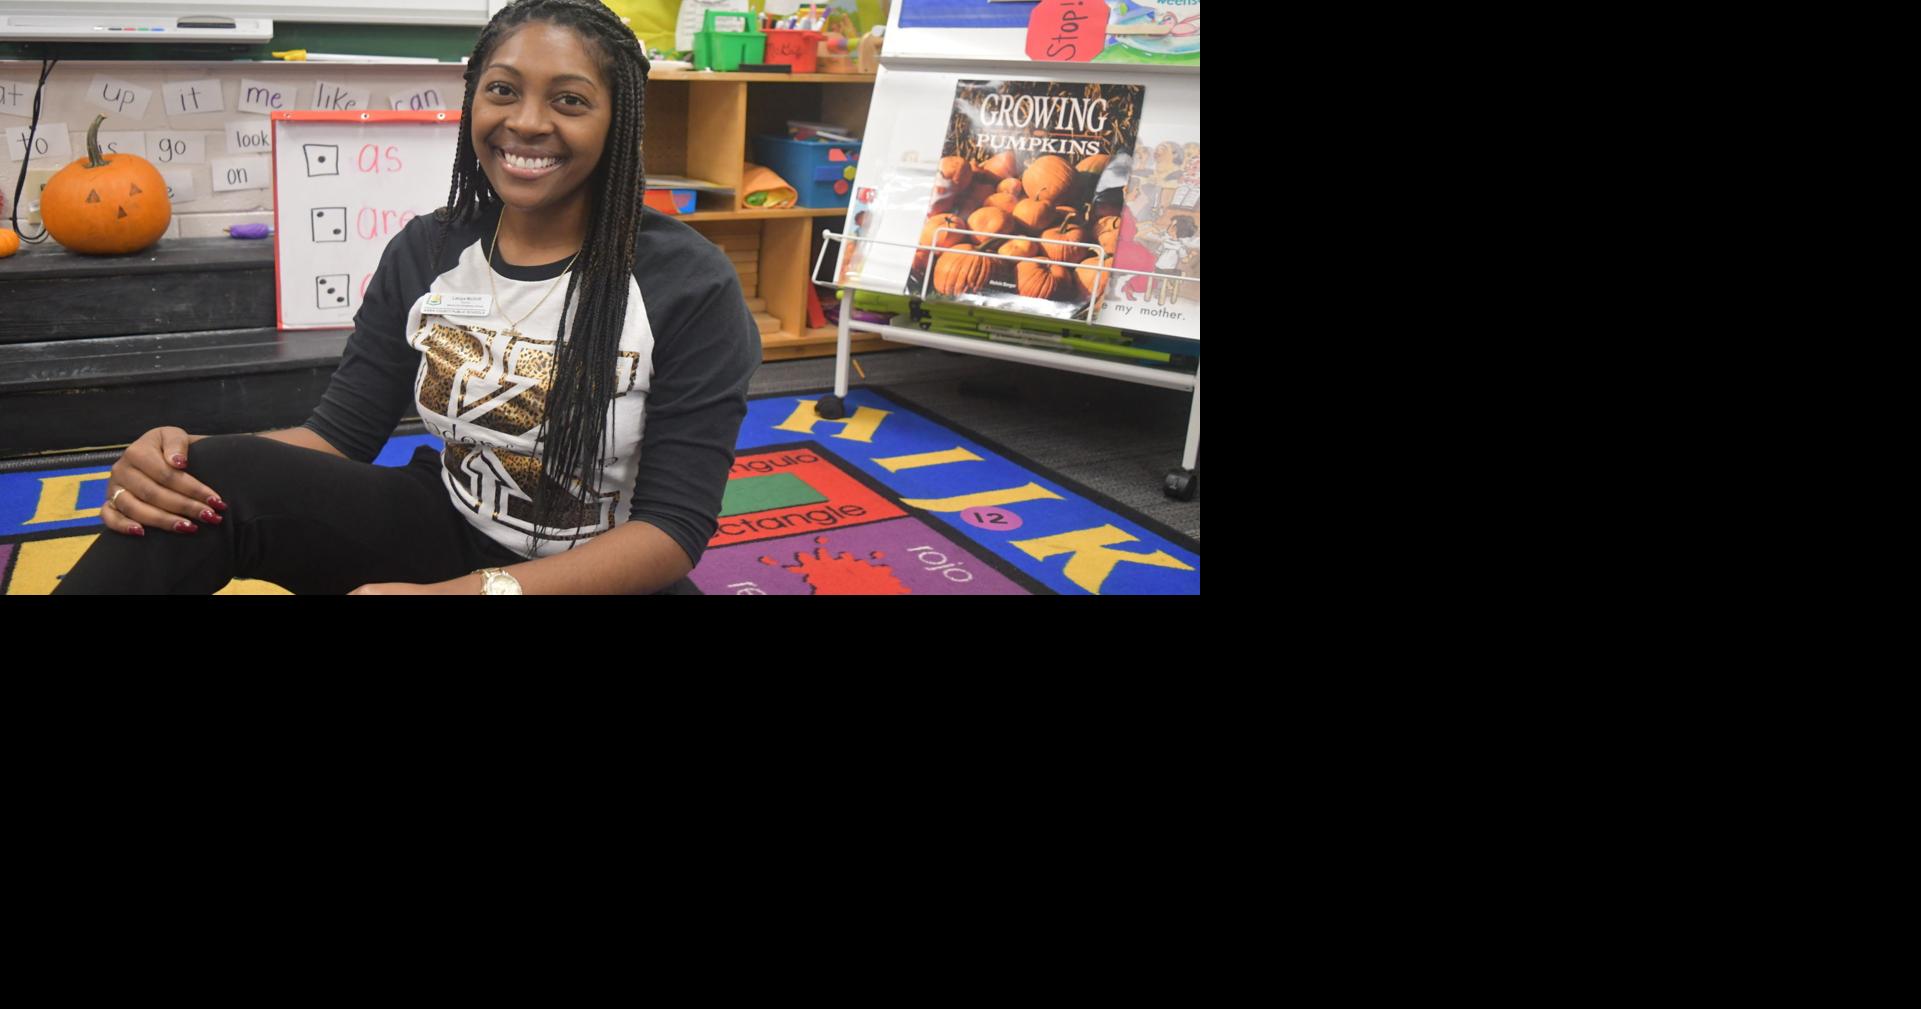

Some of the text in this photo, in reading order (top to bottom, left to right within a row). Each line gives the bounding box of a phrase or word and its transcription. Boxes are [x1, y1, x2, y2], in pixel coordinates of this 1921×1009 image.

[1046, 1, 1088, 61] Stop!
[103, 83, 135, 112] up
[179, 87, 201, 111] it
[247, 87, 284, 109] me
[317, 83, 357, 110] like
[394, 88, 439, 111] can
[981, 93, 1109, 132] GROWING
[17, 132, 48, 155] to
[158, 138, 186, 163] go
[236, 131, 270, 148] look
[976, 133, 1100, 155] PUMPKINS
[358, 143, 402, 173] as
[227, 167, 248, 185] on
[357, 207, 416, 240] are
[1115, 303, 1133, 315] my
[1140, 307, 1186, 321] mother.
[729, 454, 819, 473] ngulo
[870, 446, 985, 473] I
[900, 482, 1066, 513] J
[973, 512, 1008, 524] 12
[906, 545, 973, 582] rojo
[1008, 524, 1196, 594] K
